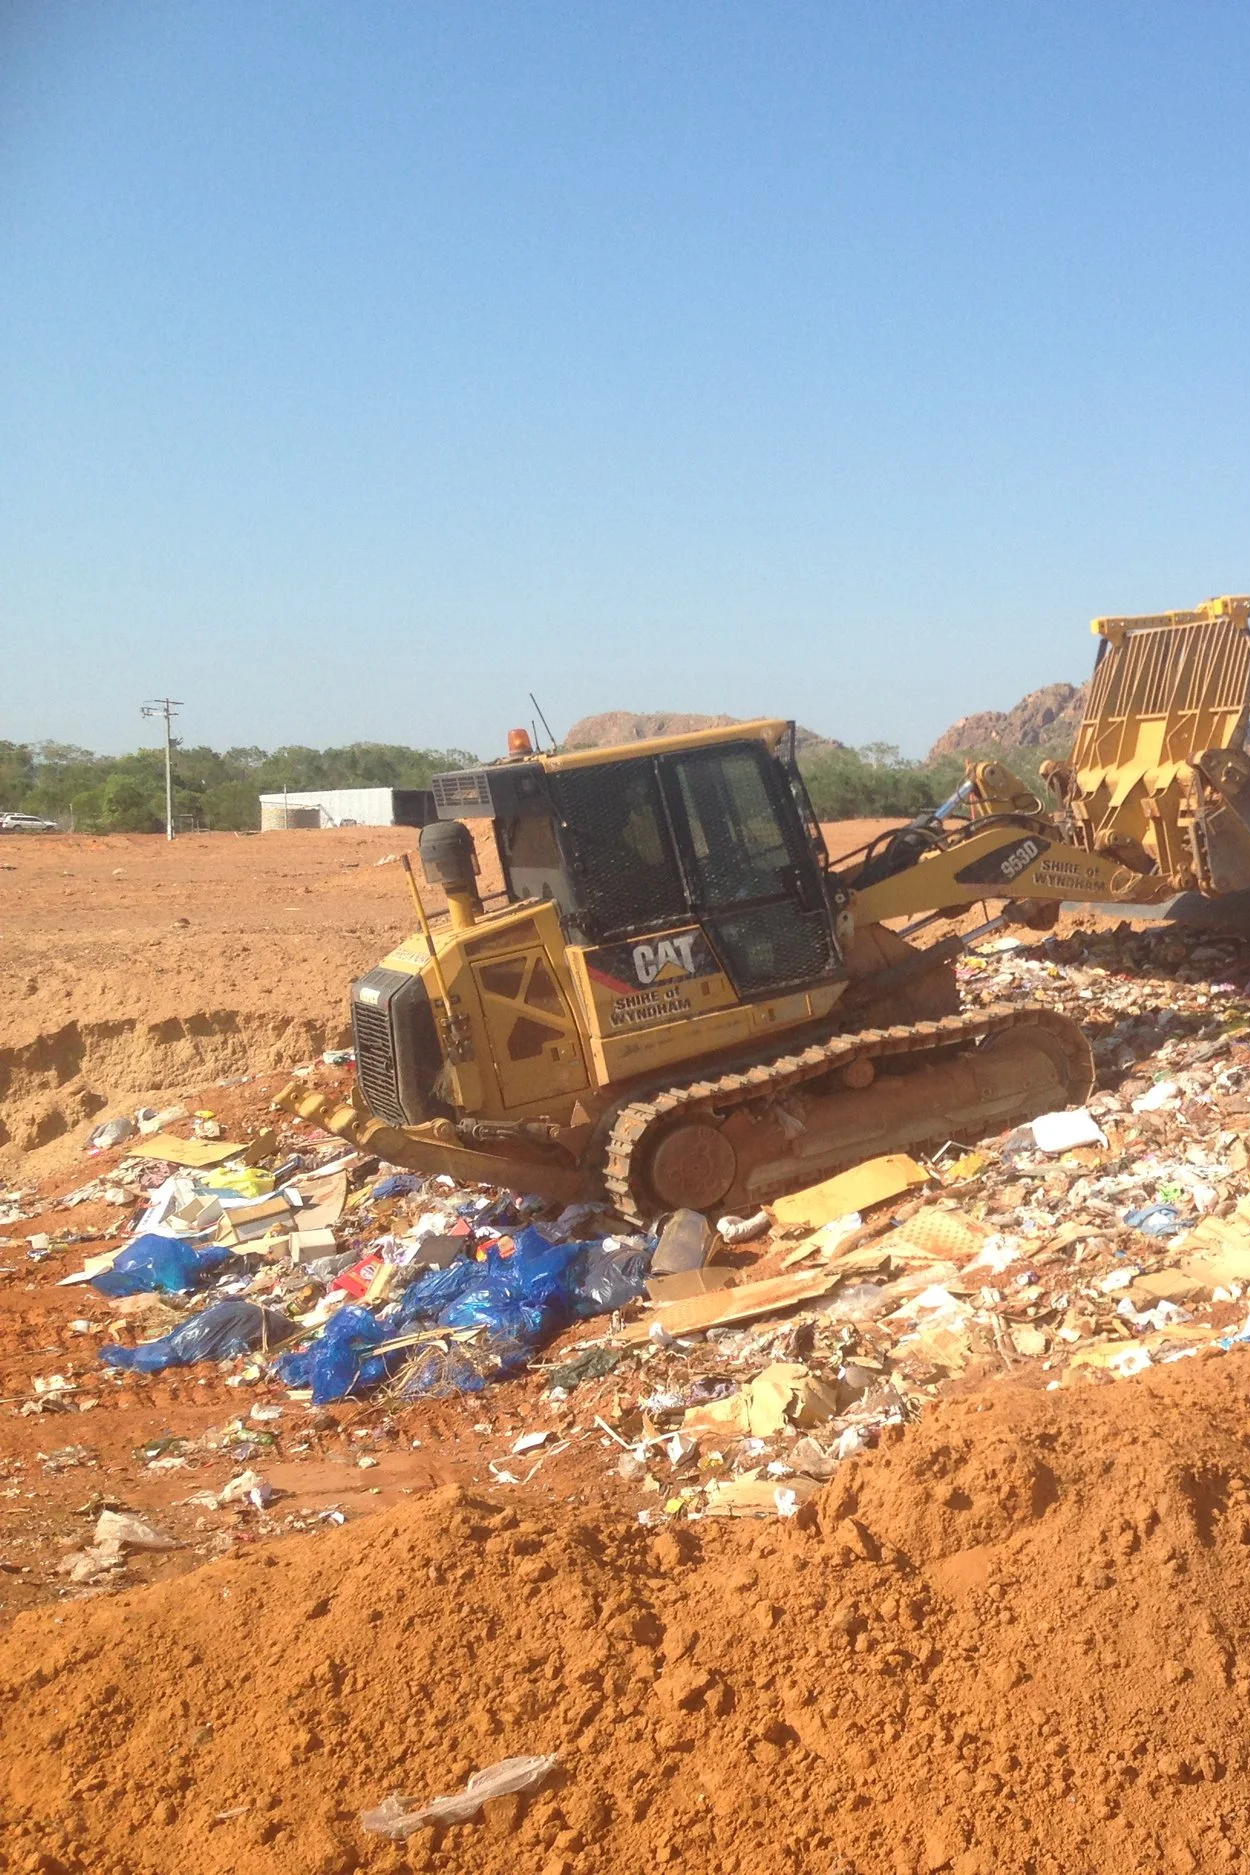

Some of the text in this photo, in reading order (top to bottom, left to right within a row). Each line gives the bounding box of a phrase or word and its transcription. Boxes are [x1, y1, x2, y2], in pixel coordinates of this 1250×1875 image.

[1001, 840, 1038, 878] 953D
[1041, 859, 1081, 875] SHIRE
[1033, 872, 1106, 892] WYNDHAM
[632, 936, 695, 984] CAT
[614, 986, 681, 1010] SHIRE of
[610, 999, 691, 1028] WYNDHAM
